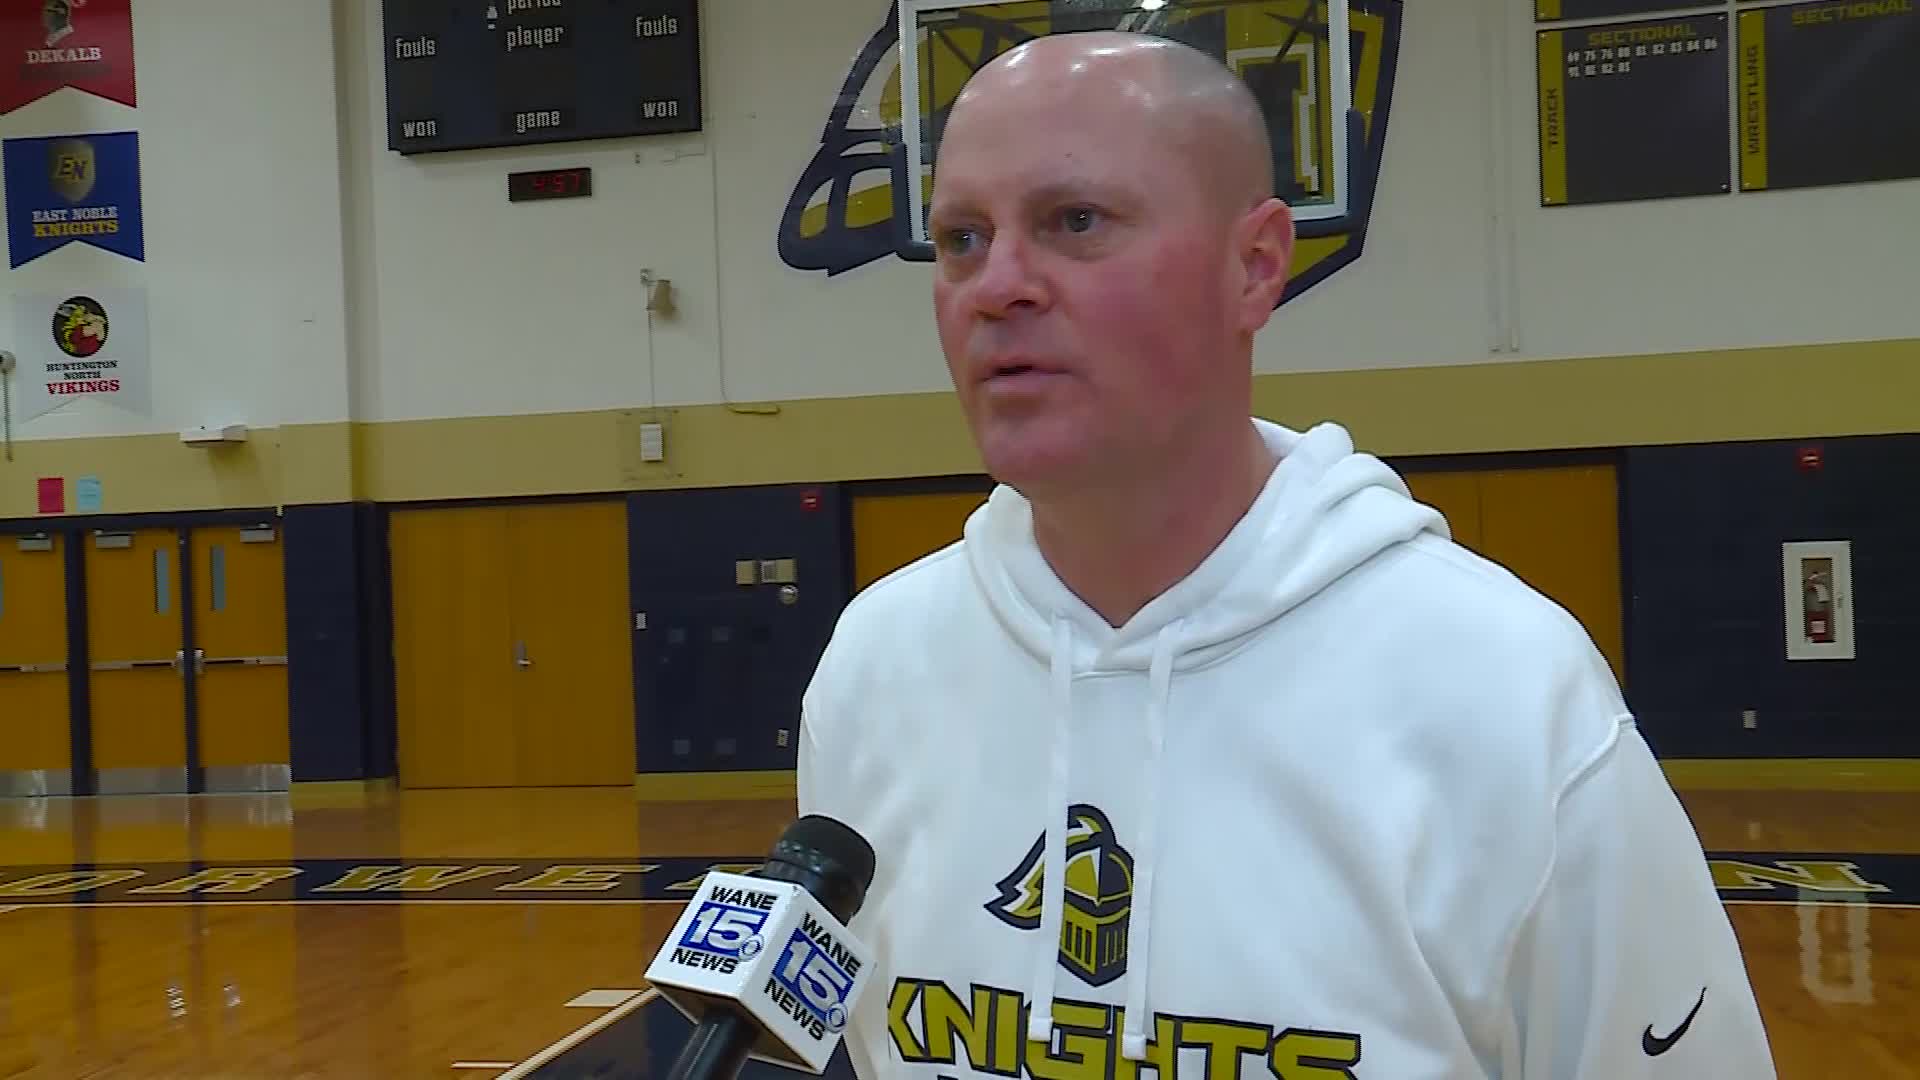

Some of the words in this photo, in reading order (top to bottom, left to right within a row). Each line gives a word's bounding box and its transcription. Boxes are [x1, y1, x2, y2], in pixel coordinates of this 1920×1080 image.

[507, 25, 564, 52] player
[1587, 24, 1697, 46] SECTIONAL
[26, 47, 102, 64] DEKALB
[643, 100, 679, 118] won
[1746, 46, 1761, 155] WRESTLING
[402, 119, 437, 138] won
[516, 109, 561, 133] game
[1546, 88, 1559, 149] TRACK
[32, 209, 68, 223] EAST
[72, 206, 119, 220] NOBLE
[33, 220, 119, 238] KNIGHTS
[46, 360, 118, 372] HUNTINGTON
[63, 370, 102, 381] NORTH
[46, 380, 121, 395] VIKINGS
[0, 864, 765, 898] ORWE
[709, 885, 779, 911] WANE
[689, 904, 763, 953] 15
[801, 911, 863, 979] WANE
[669, 947, 740, 976] NEWS
[783, 938, 852, 1011] 15
[764, 976, 827, 1042] NEWS
[887, 976, 1362, 1080] KNIGHTS
